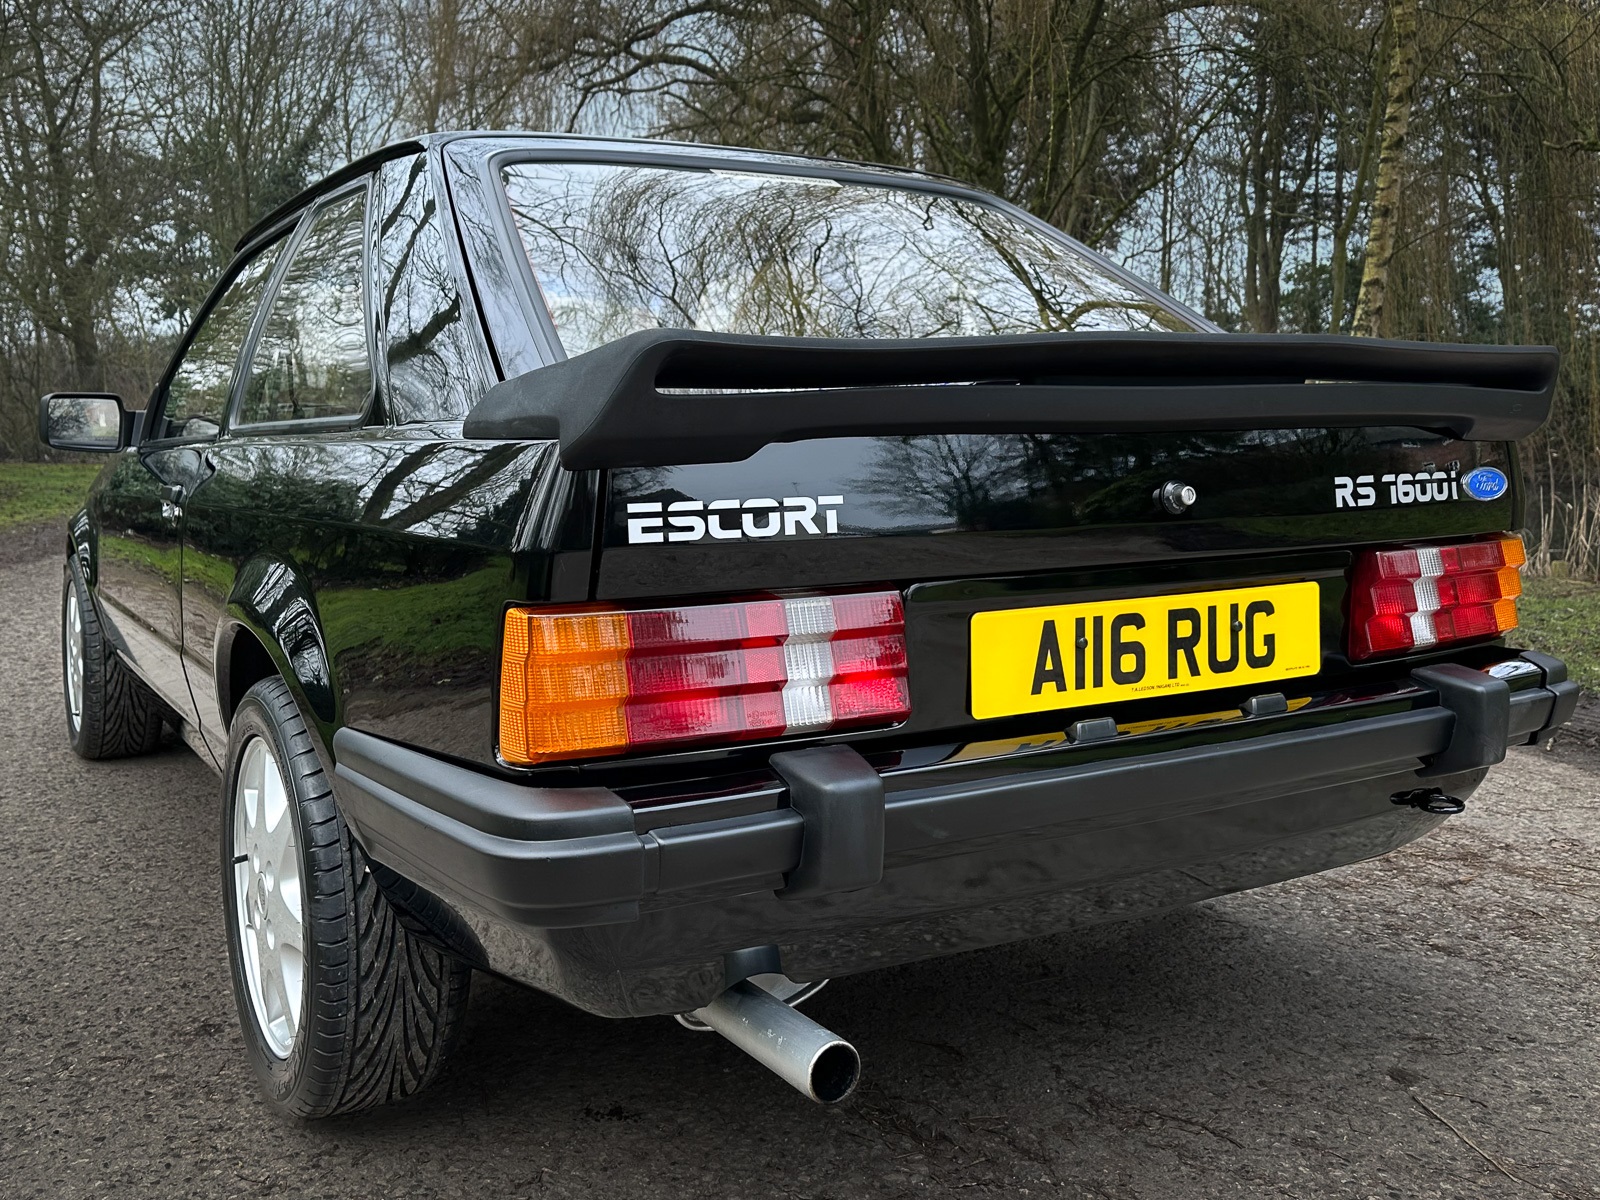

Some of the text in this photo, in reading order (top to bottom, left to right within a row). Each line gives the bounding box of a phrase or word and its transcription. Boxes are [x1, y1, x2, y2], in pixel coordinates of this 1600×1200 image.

[1334, 470, 1459, 508] RS 1600i
[1475, 472, 1500, 492] Ford
[626, 494, 844, 545] ESCORT
[1030, 599, 1276, 696] A116 RUG
